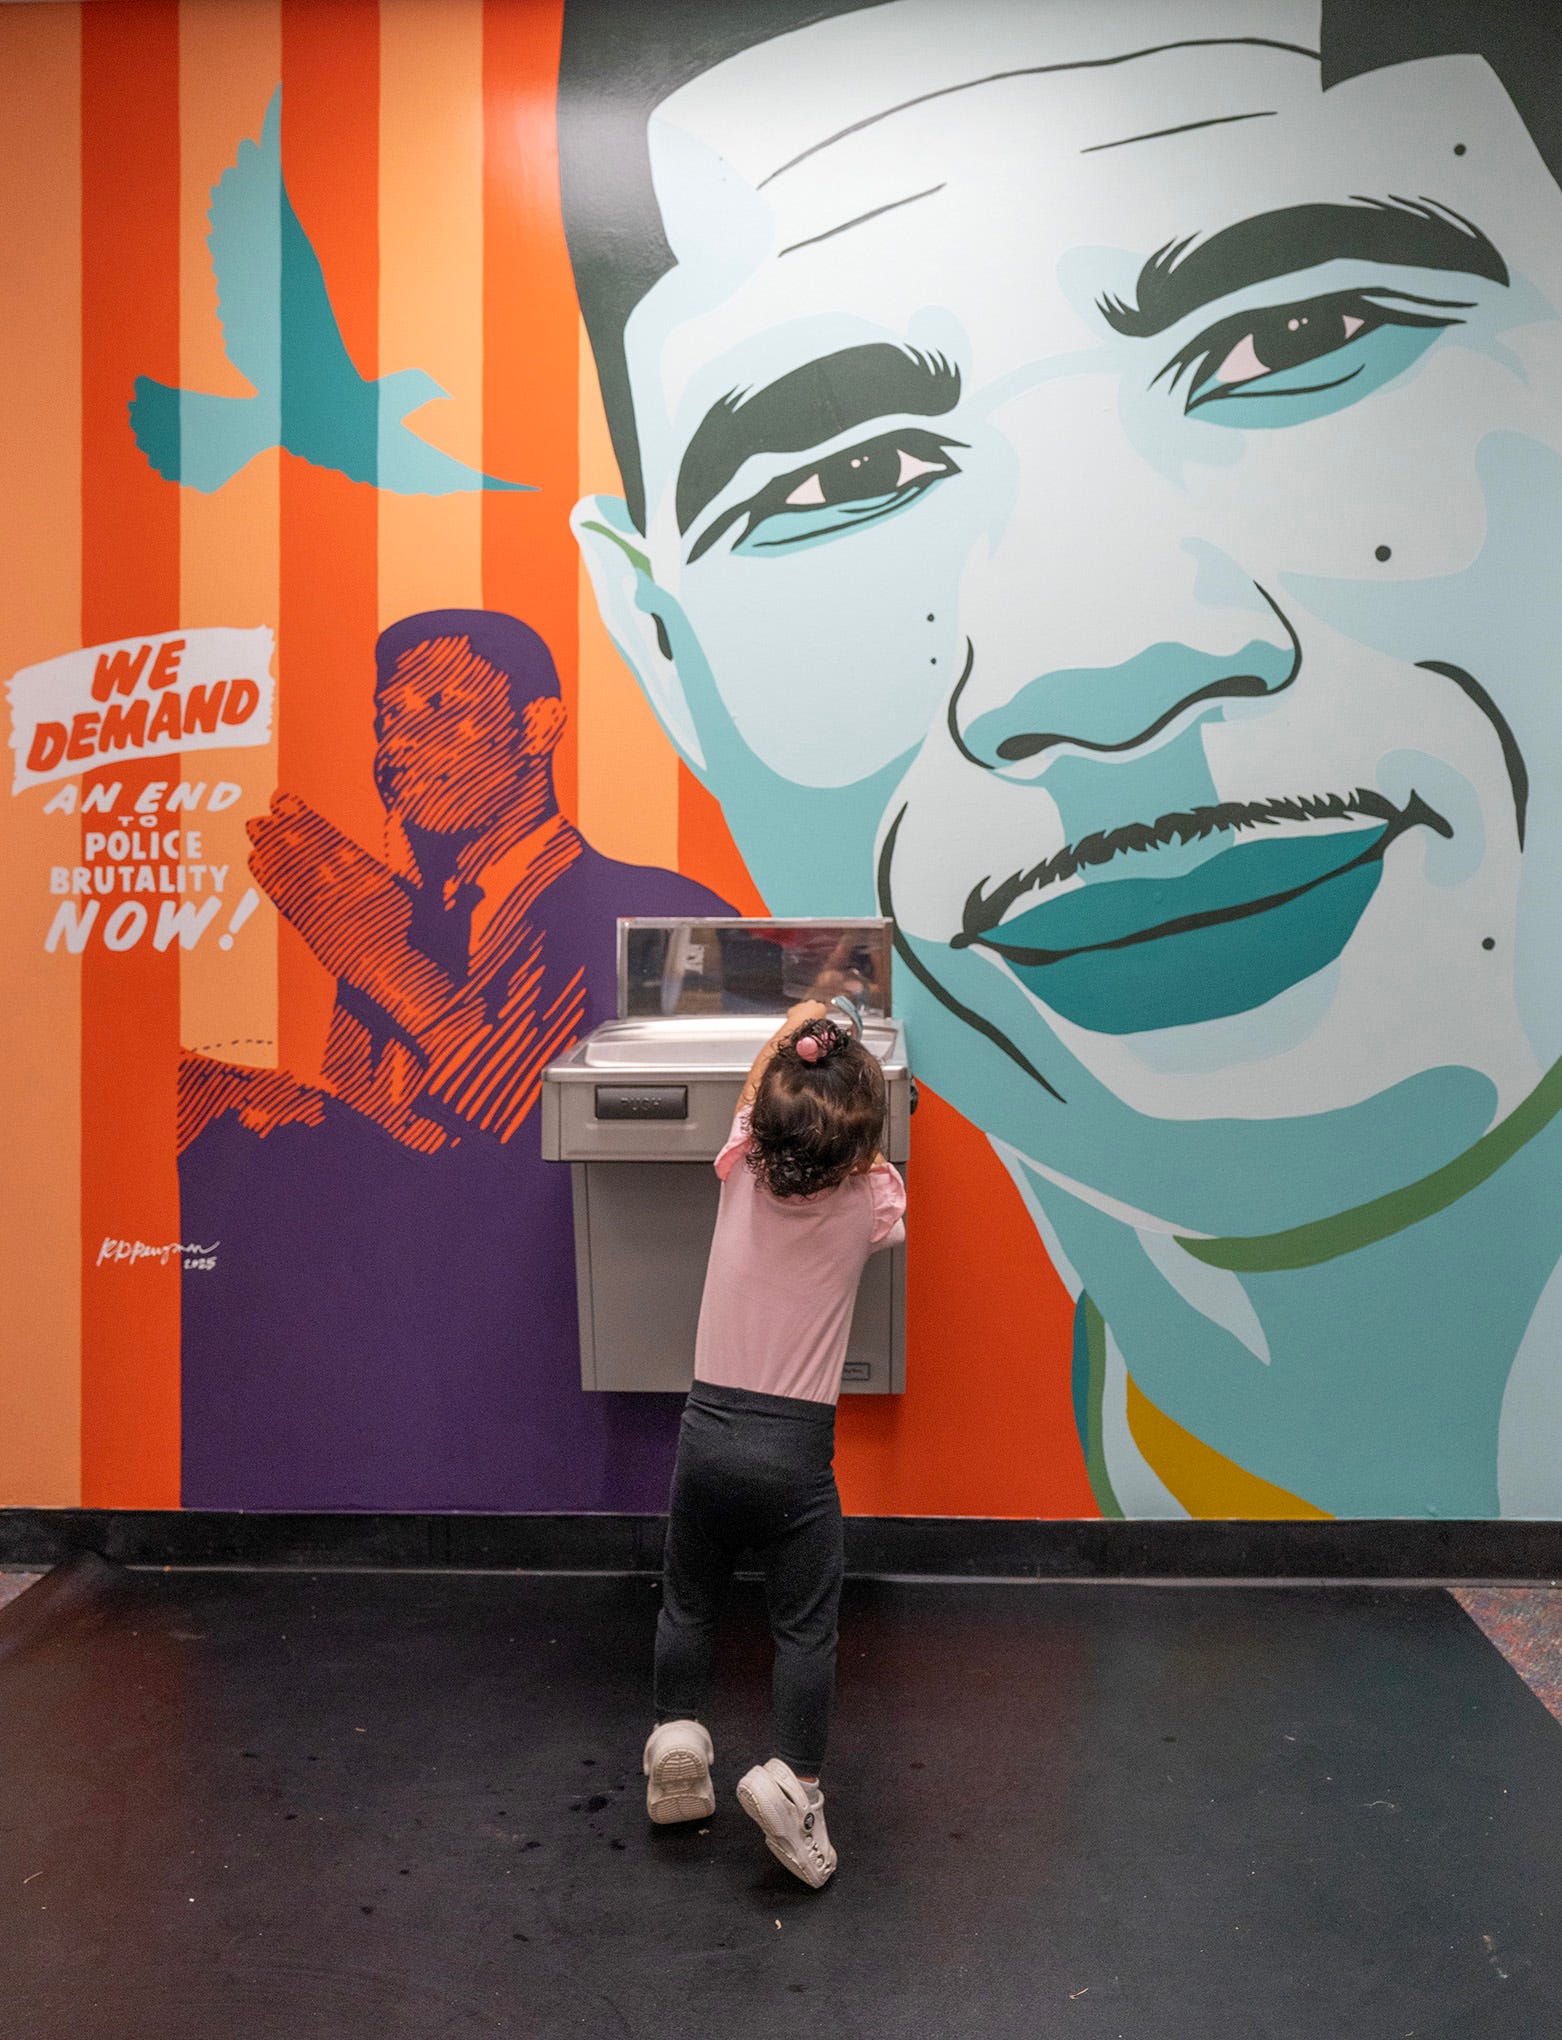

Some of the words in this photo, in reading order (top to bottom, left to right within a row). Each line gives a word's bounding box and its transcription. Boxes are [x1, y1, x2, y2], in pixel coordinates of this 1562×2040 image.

[92, 639, 186, 702] WE
[26, 678, 260, 772] DEMAND
[43, 782, 122, 815] AN
[134, 782, 242, 813] END
[118, 815, 158, 828] TO
[85, 830, 202, 861] POLICE
[50, 865, 229, 895] BRUTALITY
[44, 887, 260, 955] NOW!
